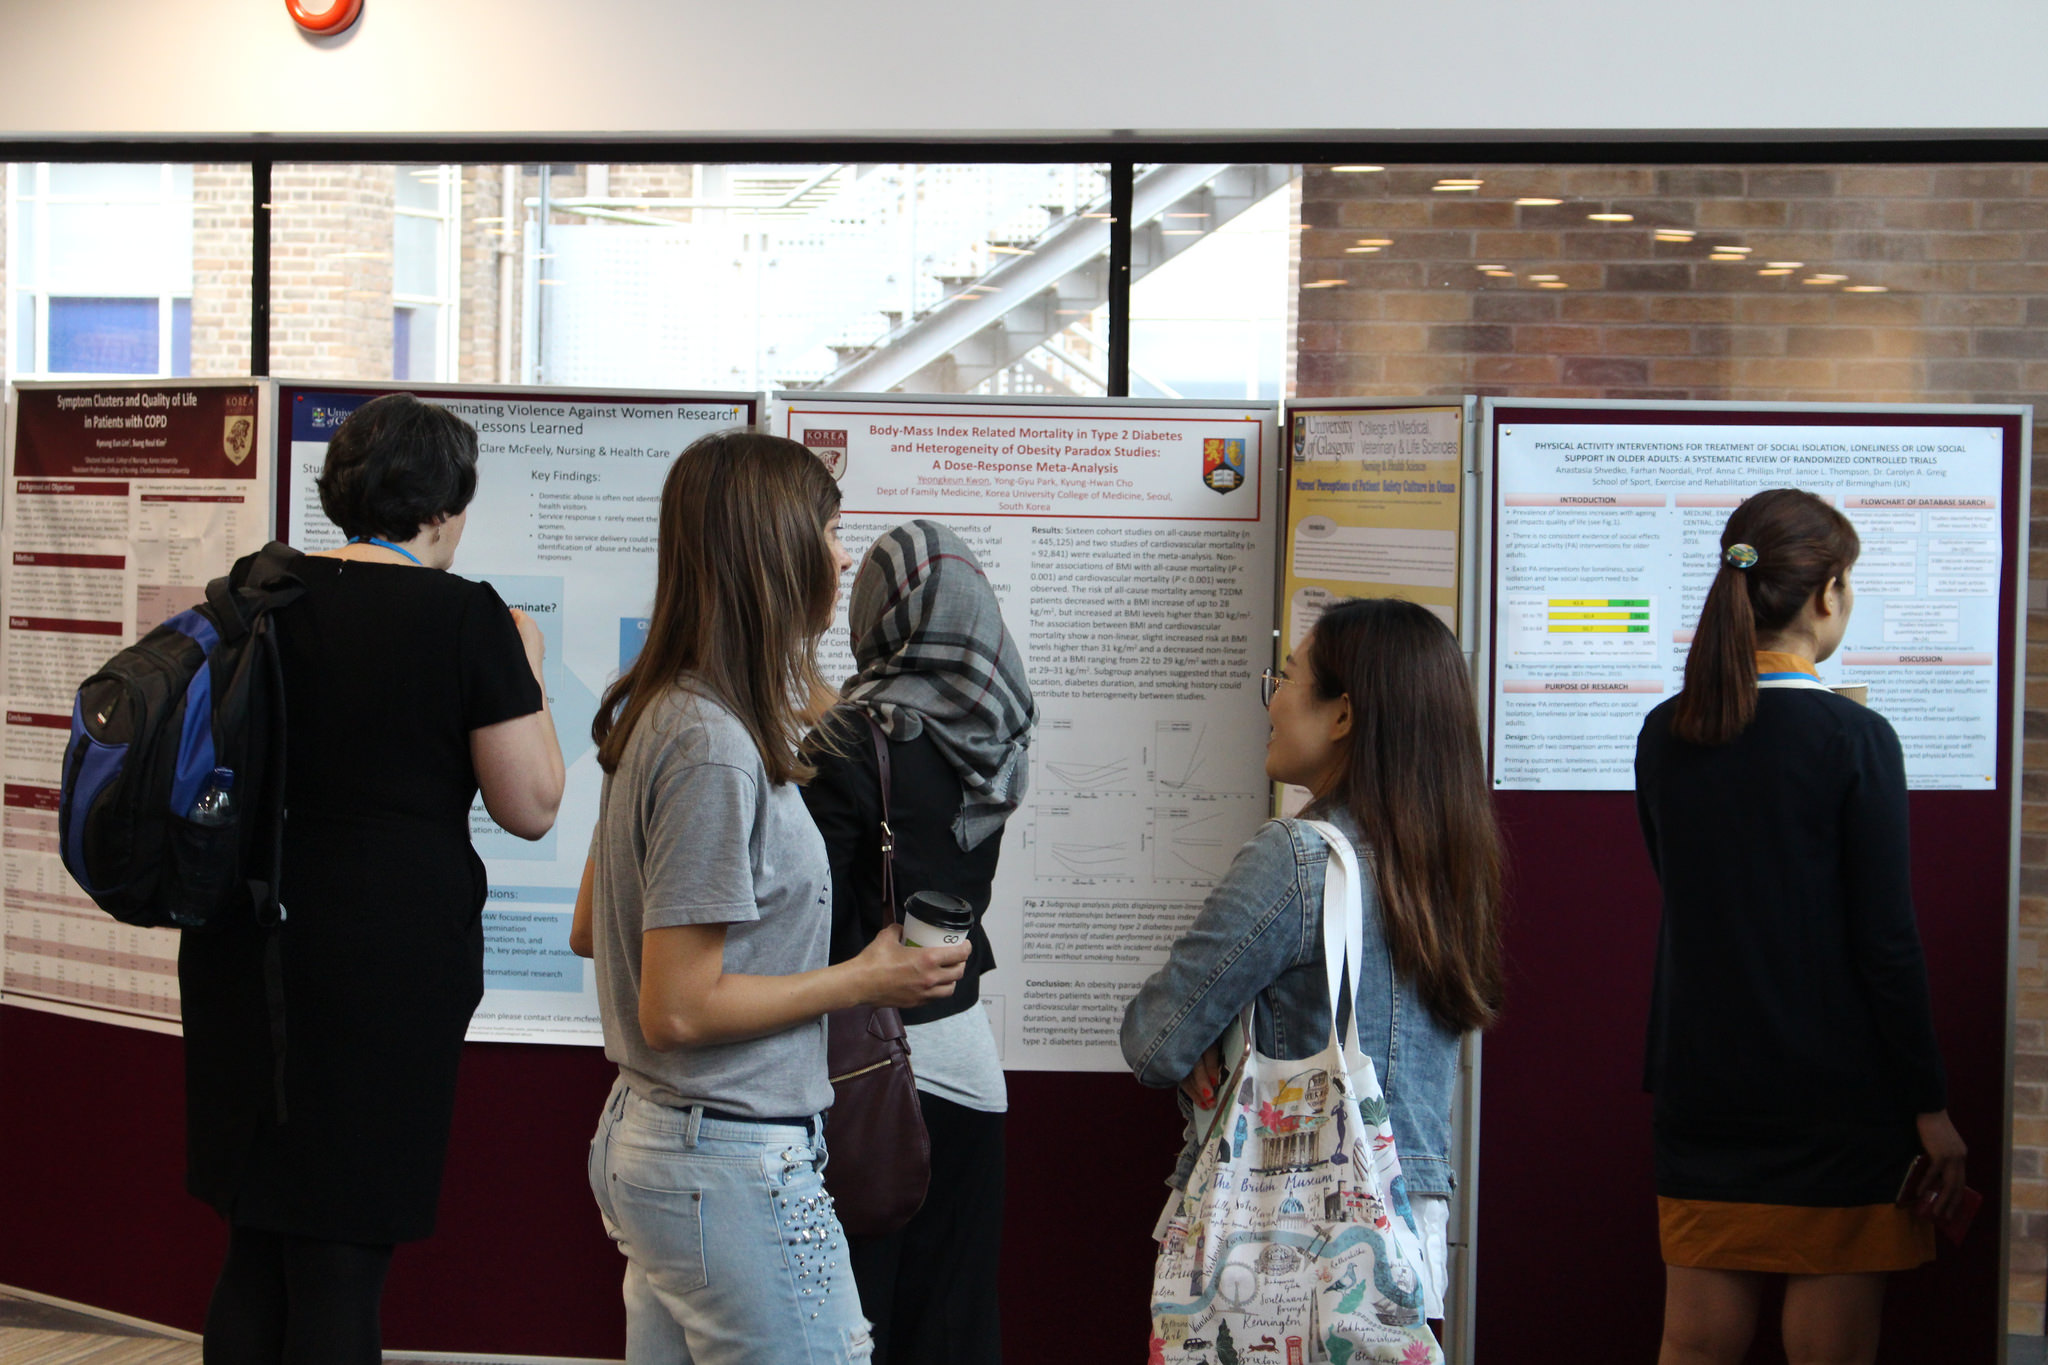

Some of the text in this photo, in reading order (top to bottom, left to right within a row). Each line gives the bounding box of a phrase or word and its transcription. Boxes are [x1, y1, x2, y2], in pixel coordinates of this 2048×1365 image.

[57, 392, 198, 410] Symptom Clusters and Quality of Life
[226, 397, 253, 406] KOREA
[442, 402, 737, 420] minating Violence Against Women Research
[84, 414, 167, 427] in Patients with COPD
[475, 420, 583, 434] Lessons Learned
[806, 431, 845, 440] KOREA
[869, 425, 1183, 441] Body-Mass Index Related Mortality in Type 2 Diabetes
[1359, 421, 1387, 438] College
[1390, 420, 1397, 434] of
[479, 443, 670, 457] Clare McFeely, Nursing & Health Care
[890, 442, 1161, 457] and Heterogeneity of Obesity Paradox Studies:
[1361, 440, 1396, 457] Veterinary
[1405, 440, 1420, 455] Life
[1422, 439, 1458, 455] Sciences
[1616, 442, 1683, 450] INTERVENTIONS
[1801, 444, 1848, 452] ISOLATION,
[1850, 444, 1899, 452] LONELINESS
[1909, 456, 1938, 464] TRIALS
[932, 460, 1118, 475] A Dose-Response Meta-Analysis
[531, 470, 601, 483] Key Findings:
[917, 475, 964, 486] Yeongkeun
[994, 477, 1035, 487] Yong-Gyu
[1036, 477, 1059, 487] Park,
[1060, 478, 1114, 488] Kyung-Hwan
[1115, 478, 1133, 487] Cho
[1629, 478, 1652, 486] Sport,
[1703, 478, 1757, 486] Rehabilitation
[1794, 479, 1834, 487] University
[1844, 479, 1892, 488] Birmingham
[1893, 479, 1911, 487] (UK)
[876, 486, 1173, 502] Dept of Family Medicine, Korea University College of Medicine, Seoul,
[999, 502, 1024, 510] South
[1032, 526, 1063, 534] Results:
[1095, 527, 1122, 535] cohort
[1166, 528, 1201, 536] all-cause
[1203, 529, 1240, 538] mortality
[500, 913, 532, 921] focussed
[944, 935, 959, 944] GO
[497, 946, 510, 955] key
[510, 947, 537, 956] people
[531, 969, 562, 977] research
[1026, 979, 1072, 987] Conclusion:
[1086, 980, 1115, 989] obesity
[1243, 1315, 1302, 1335] Kennington
